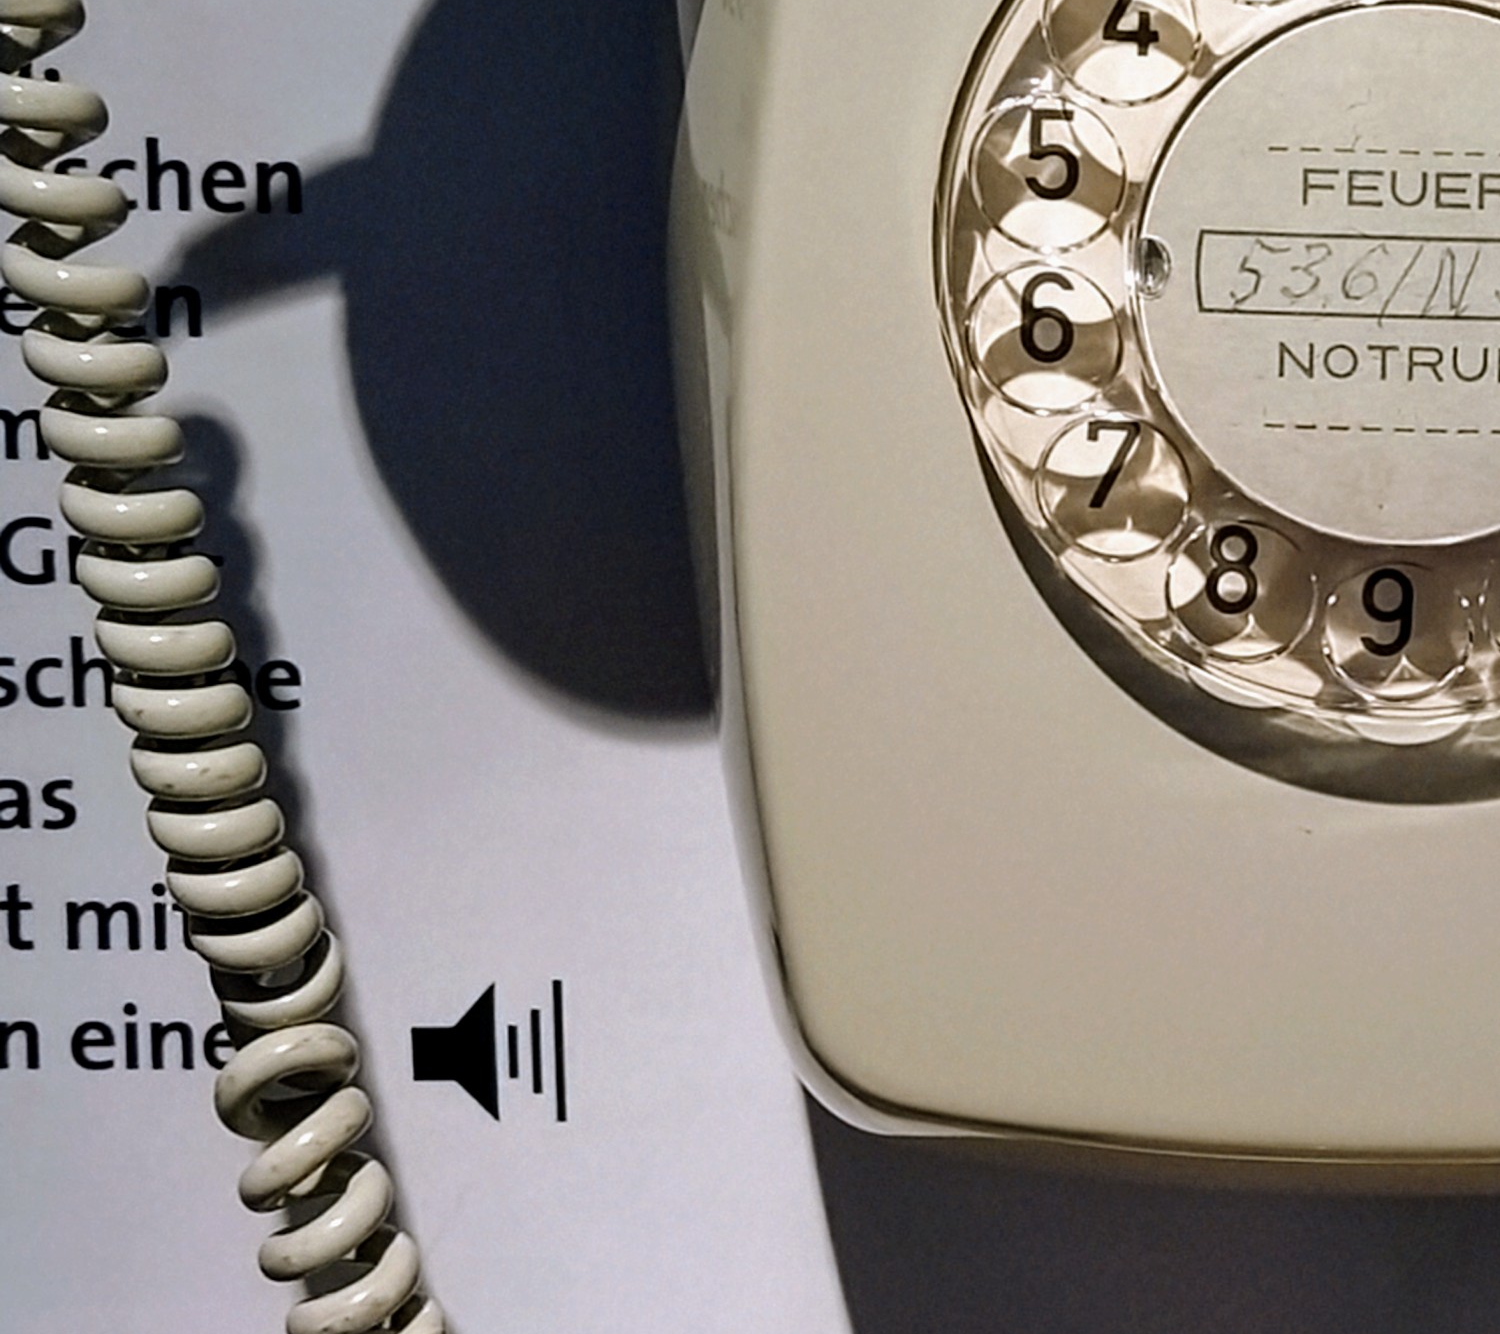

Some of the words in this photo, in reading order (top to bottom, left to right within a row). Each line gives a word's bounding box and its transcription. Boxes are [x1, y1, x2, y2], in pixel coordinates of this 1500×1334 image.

[1026, 109, 1080, 200] 5
[1019, 271, 1074, 364] 6
[1086, 421, 1141, 509] 7
[1204, 524, 1259, 615] 8
[1361, 567, 1415, 657] 9
[0, 779, 77, 829] as
